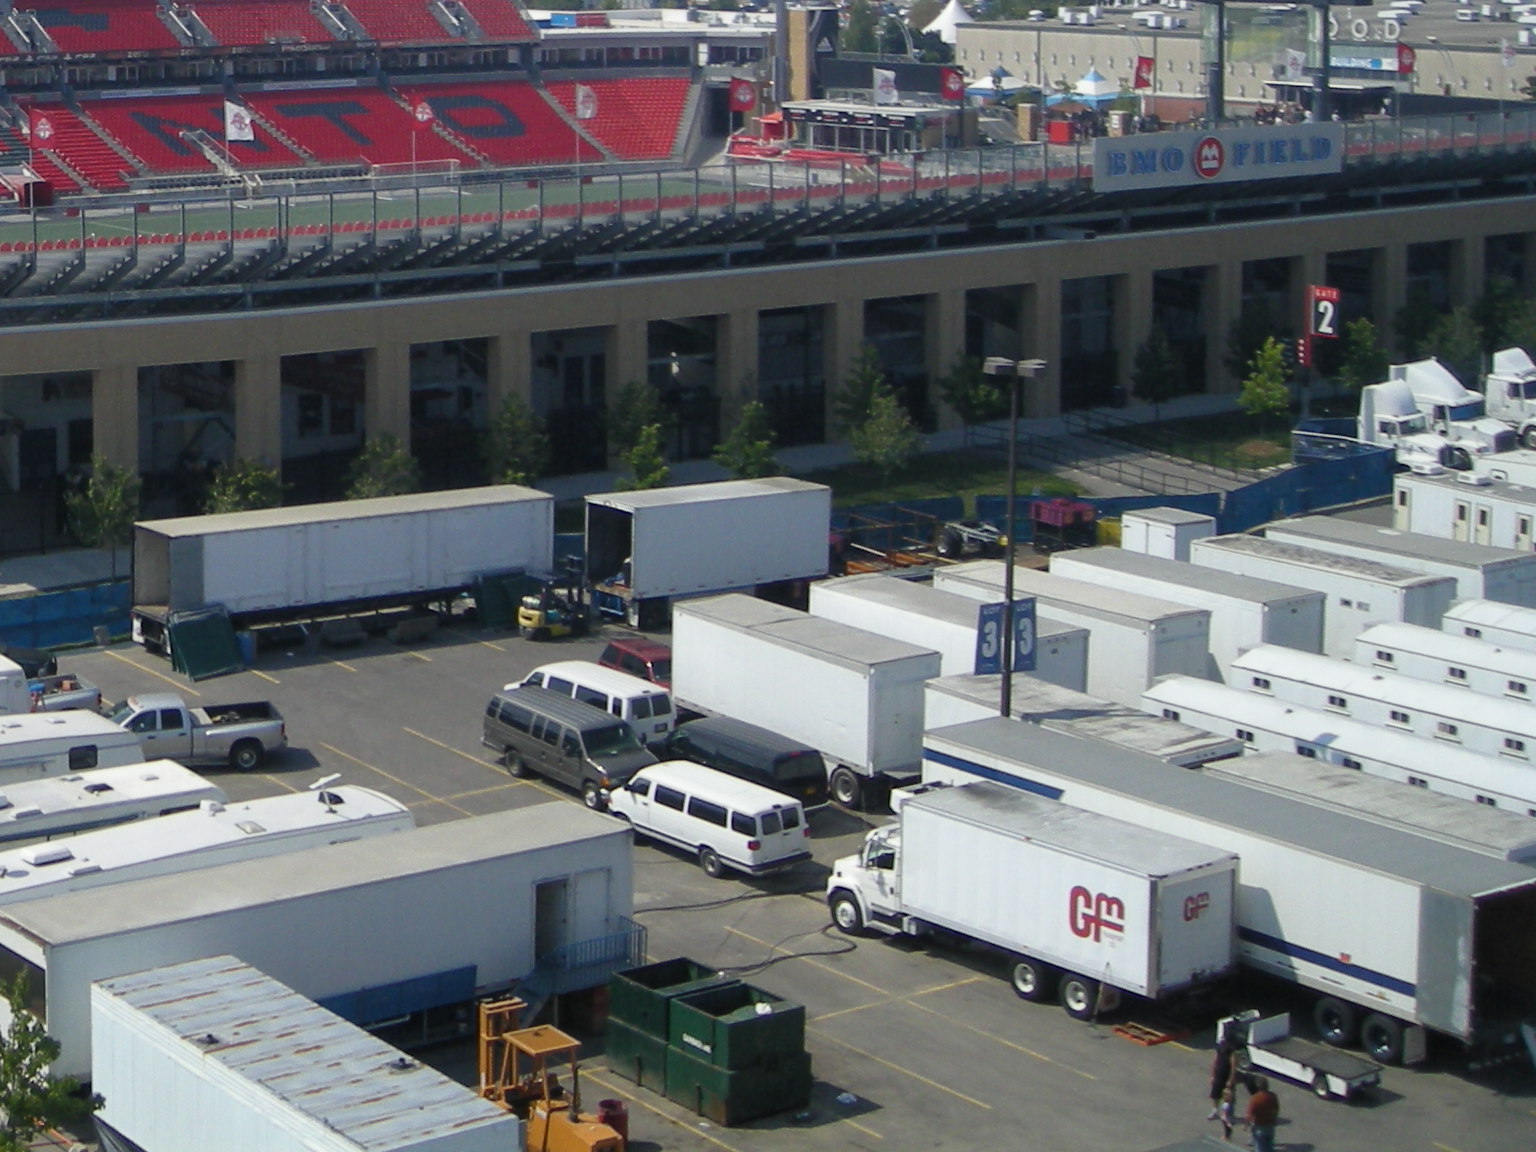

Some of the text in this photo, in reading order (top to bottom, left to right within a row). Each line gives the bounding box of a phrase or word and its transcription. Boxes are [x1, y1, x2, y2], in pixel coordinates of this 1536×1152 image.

[1329, 56, 1371, 68] BUILDING
[1107, 136, 1332, 176] BMO FIELD
[1317, 300, 1335, 334] 2
[981, 620, 999, 658] 3
[1018, 617, 1035, 655] 3
